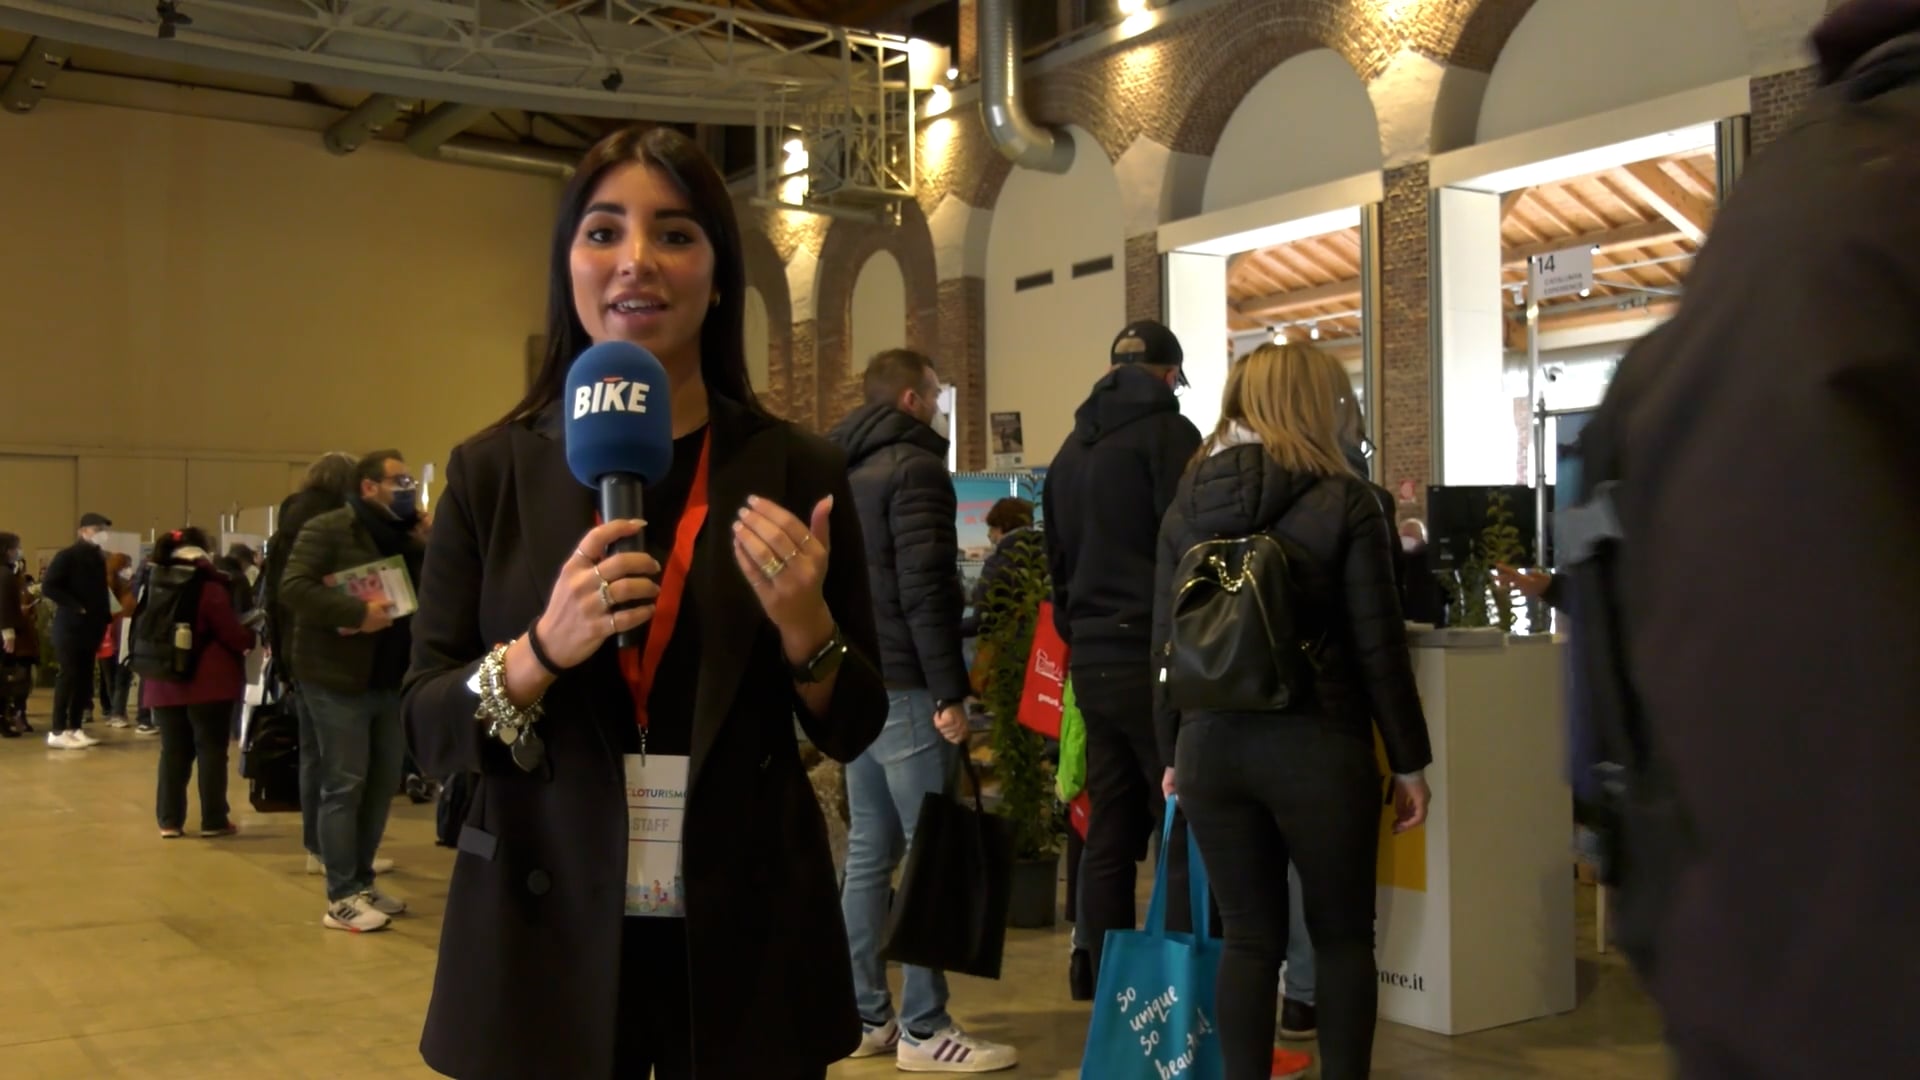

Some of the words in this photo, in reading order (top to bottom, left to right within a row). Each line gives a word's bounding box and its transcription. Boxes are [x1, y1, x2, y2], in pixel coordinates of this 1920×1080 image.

[1537, 254, 1556, 275] 14
[573, 381, 650, 420] BIKE
[632, 817, 670, 832] STAFF
[1376, 969, 1426, 992] nce.it
[1129, 985, 1179, 1032] unique
